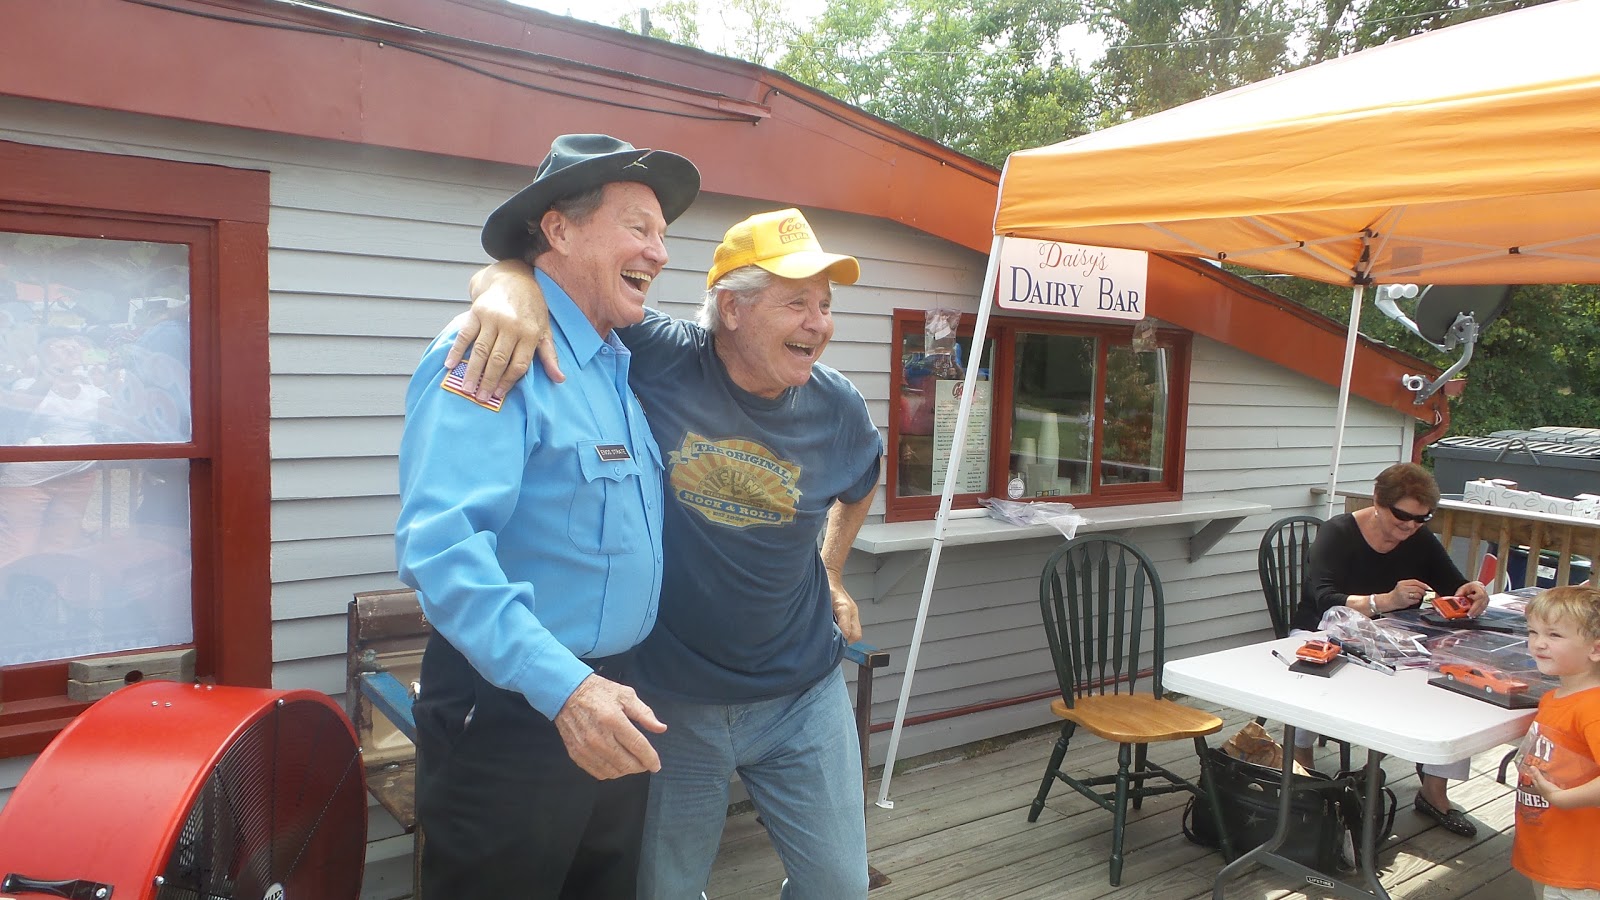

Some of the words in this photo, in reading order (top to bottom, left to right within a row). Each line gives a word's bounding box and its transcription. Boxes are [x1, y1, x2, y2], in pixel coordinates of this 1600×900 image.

[1038, 242, 1108, 277] Daisy's
[1009, 266, 1083, 307] DAIRY
[1097, 277, 1140, 313] BAR
[694, 443, 724, 455] THE
[725, 447, 790, 480] ORIGINAL
[719, 471, 760, 494] SUN
[683, 491, 723, 510] ROCK
[739, 506, 778, 520] ROLL
